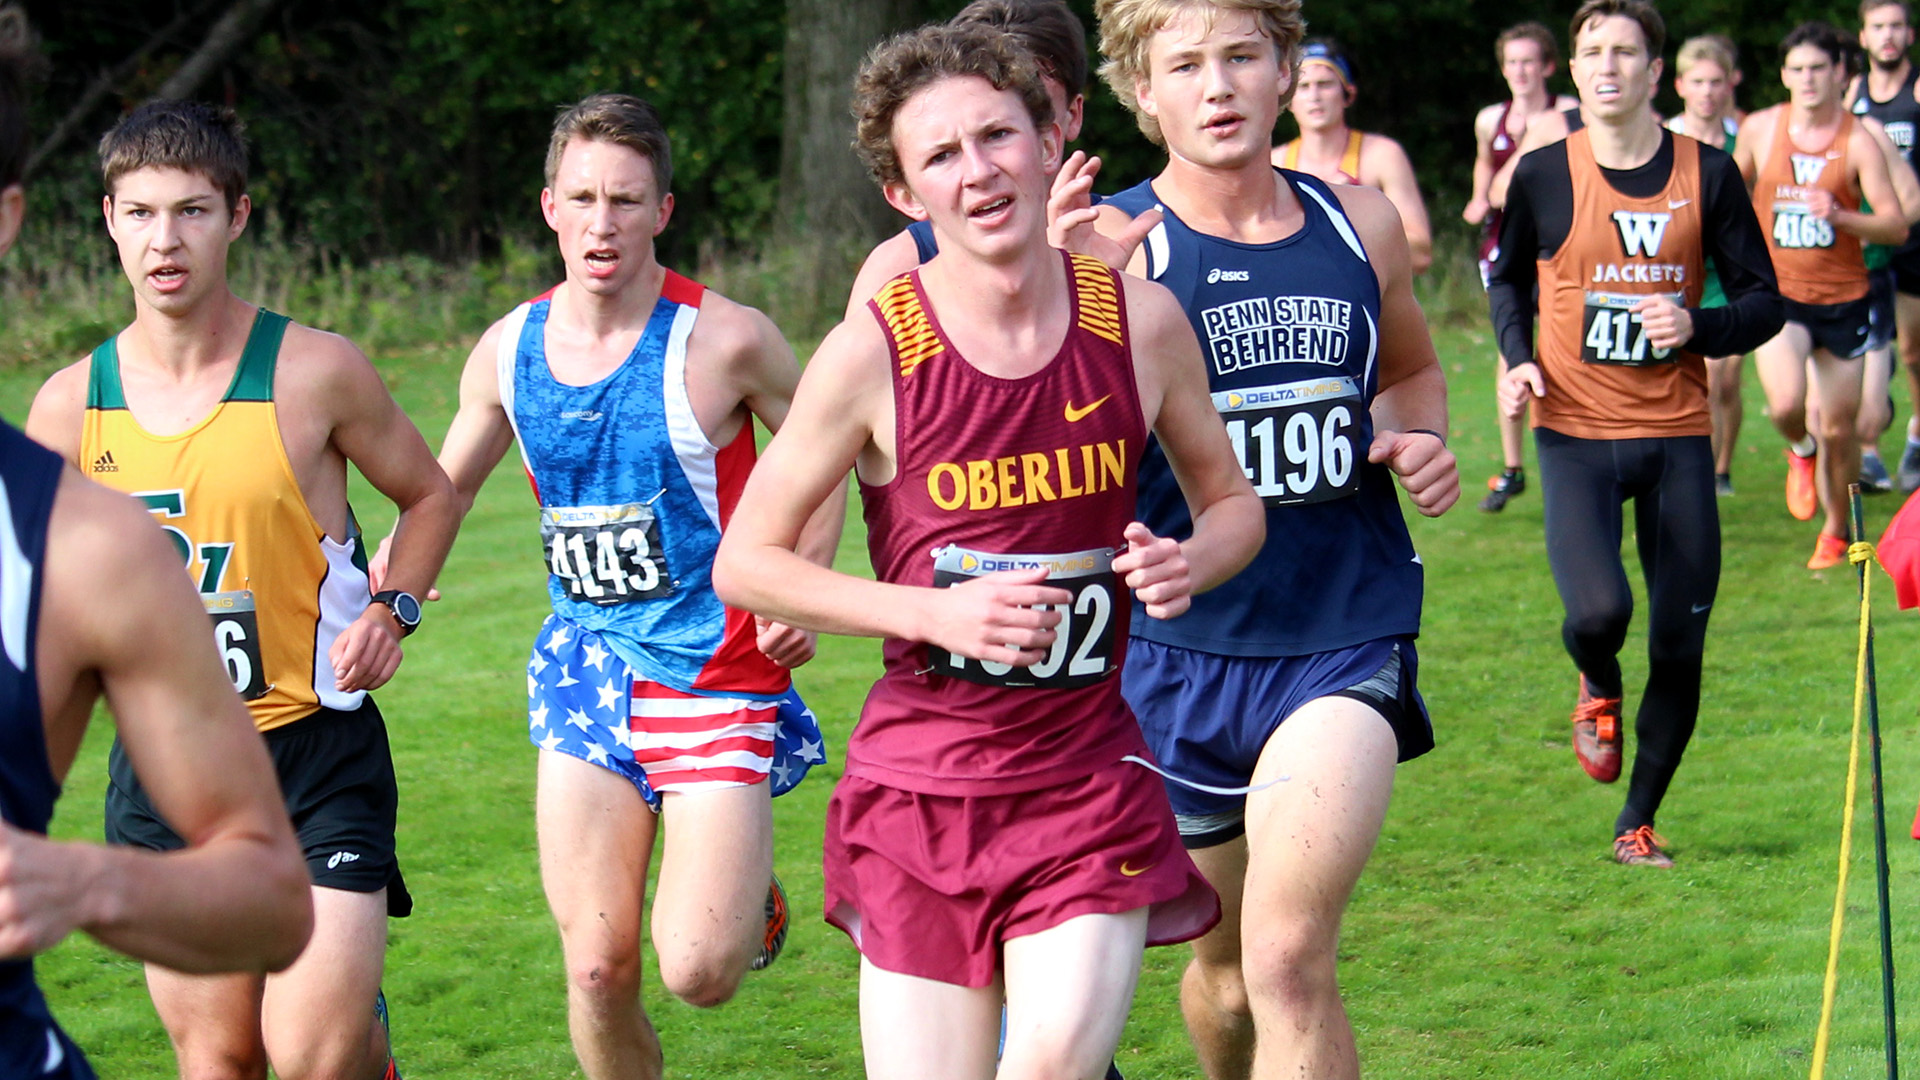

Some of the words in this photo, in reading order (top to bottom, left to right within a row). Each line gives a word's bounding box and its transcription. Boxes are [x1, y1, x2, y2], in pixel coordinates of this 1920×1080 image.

[1791, 155, 1826, 184] W
[1610, 210, 1671, 257] W
[1221, 270, 1249, 281] asics
[1592, 264, 1685, 283] JACKETS
[1201, 298, 1272, 339] PENN
[1274, 296, 1351, 330] STATE
[1585, 310, 1670, 360] 417
[1210, 326, 1349, 375] BEHREND
[927, 440, 1125, 510] OBERLIN
[551, 528, 659, 598] 4143
